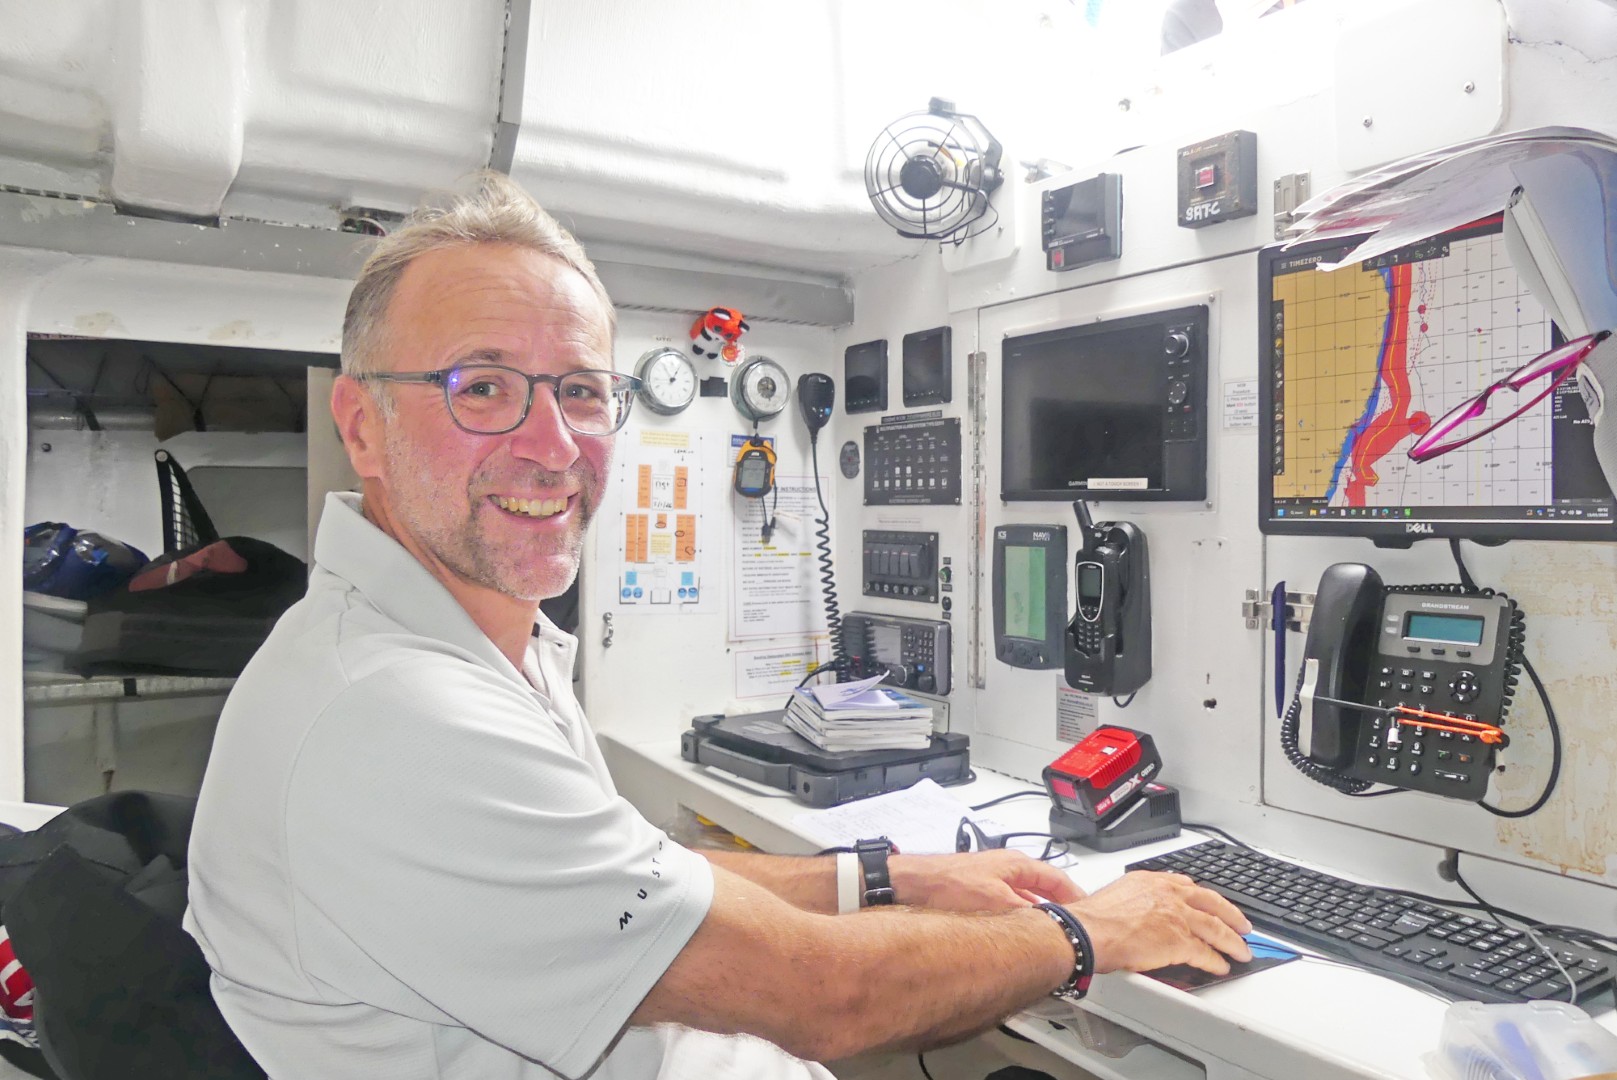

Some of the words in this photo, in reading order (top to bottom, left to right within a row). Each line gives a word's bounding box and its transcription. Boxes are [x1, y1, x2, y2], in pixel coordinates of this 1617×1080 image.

[1289, 255, 1323, 268] TIMEZERO
[1405, 523, 1434, 533] DELL
[998, 531, 1007, 539] ICS
[1421, 602, 1470, 610] GRANDSTREAM
